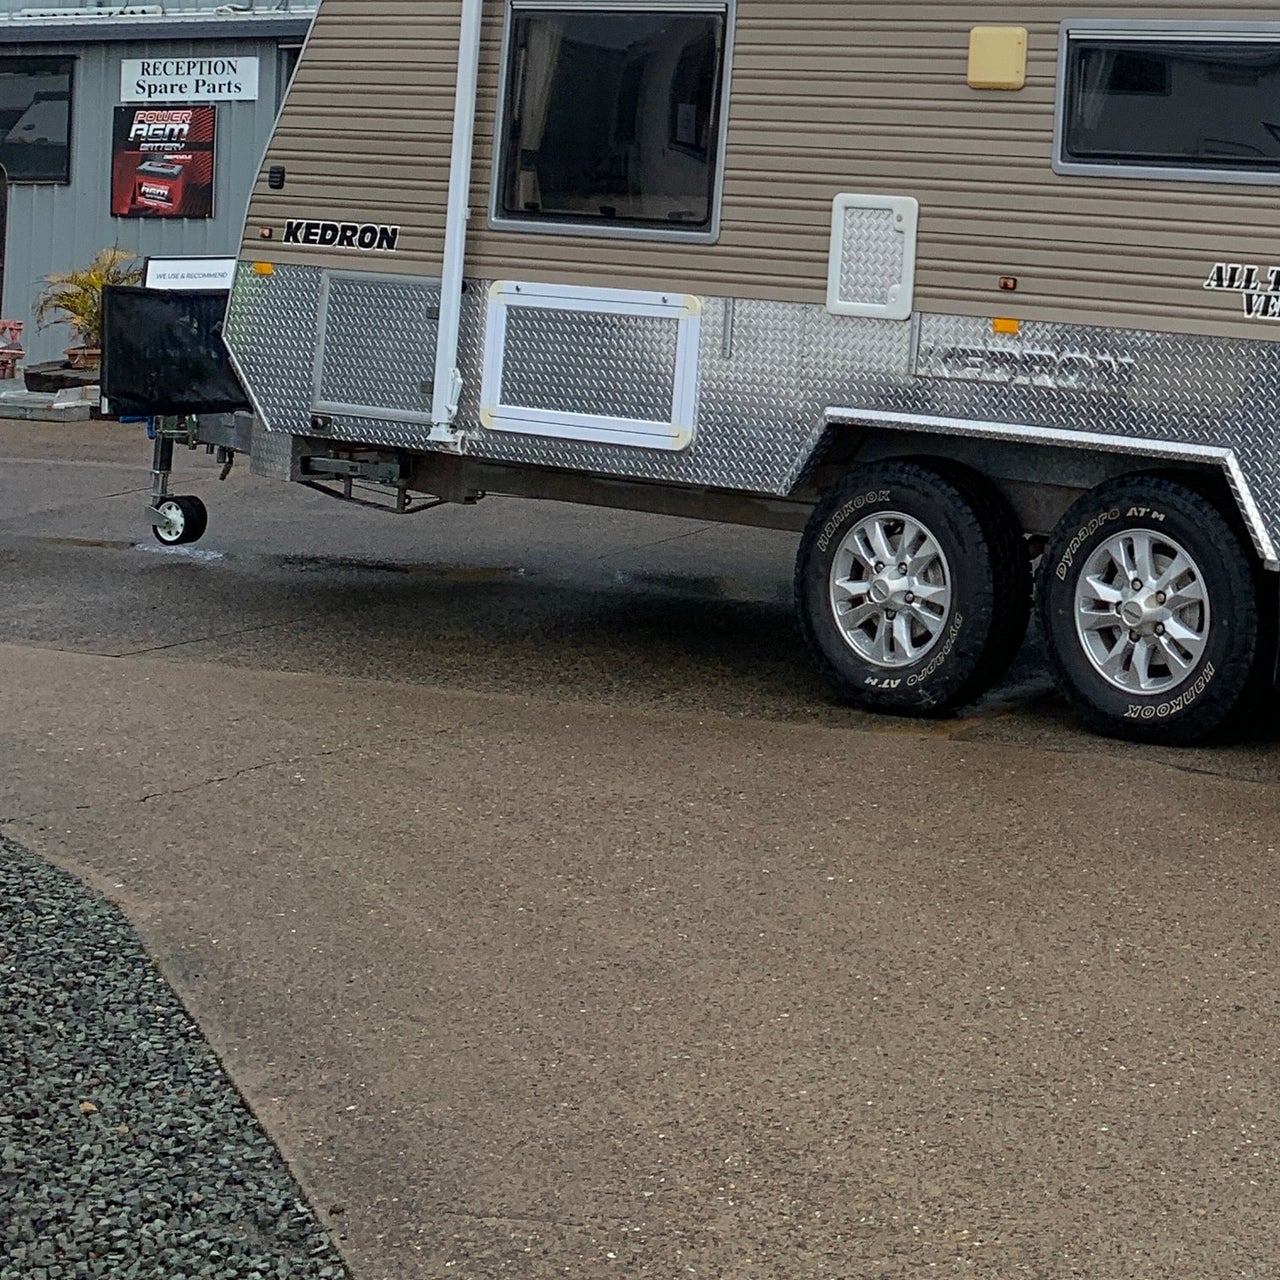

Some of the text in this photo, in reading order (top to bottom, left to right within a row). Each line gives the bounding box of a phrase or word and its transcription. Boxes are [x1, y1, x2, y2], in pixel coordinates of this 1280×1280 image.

[141, 60, 239, 77] RECEPTION
[135, 79, 242, 98] Spare Parts
[133, 110, 193, 124] POWER
[128, 124, 190, 142] AGM
[283, 219, 400, 251] KEDRON
[1203, 263, 1260, 291] ALL
